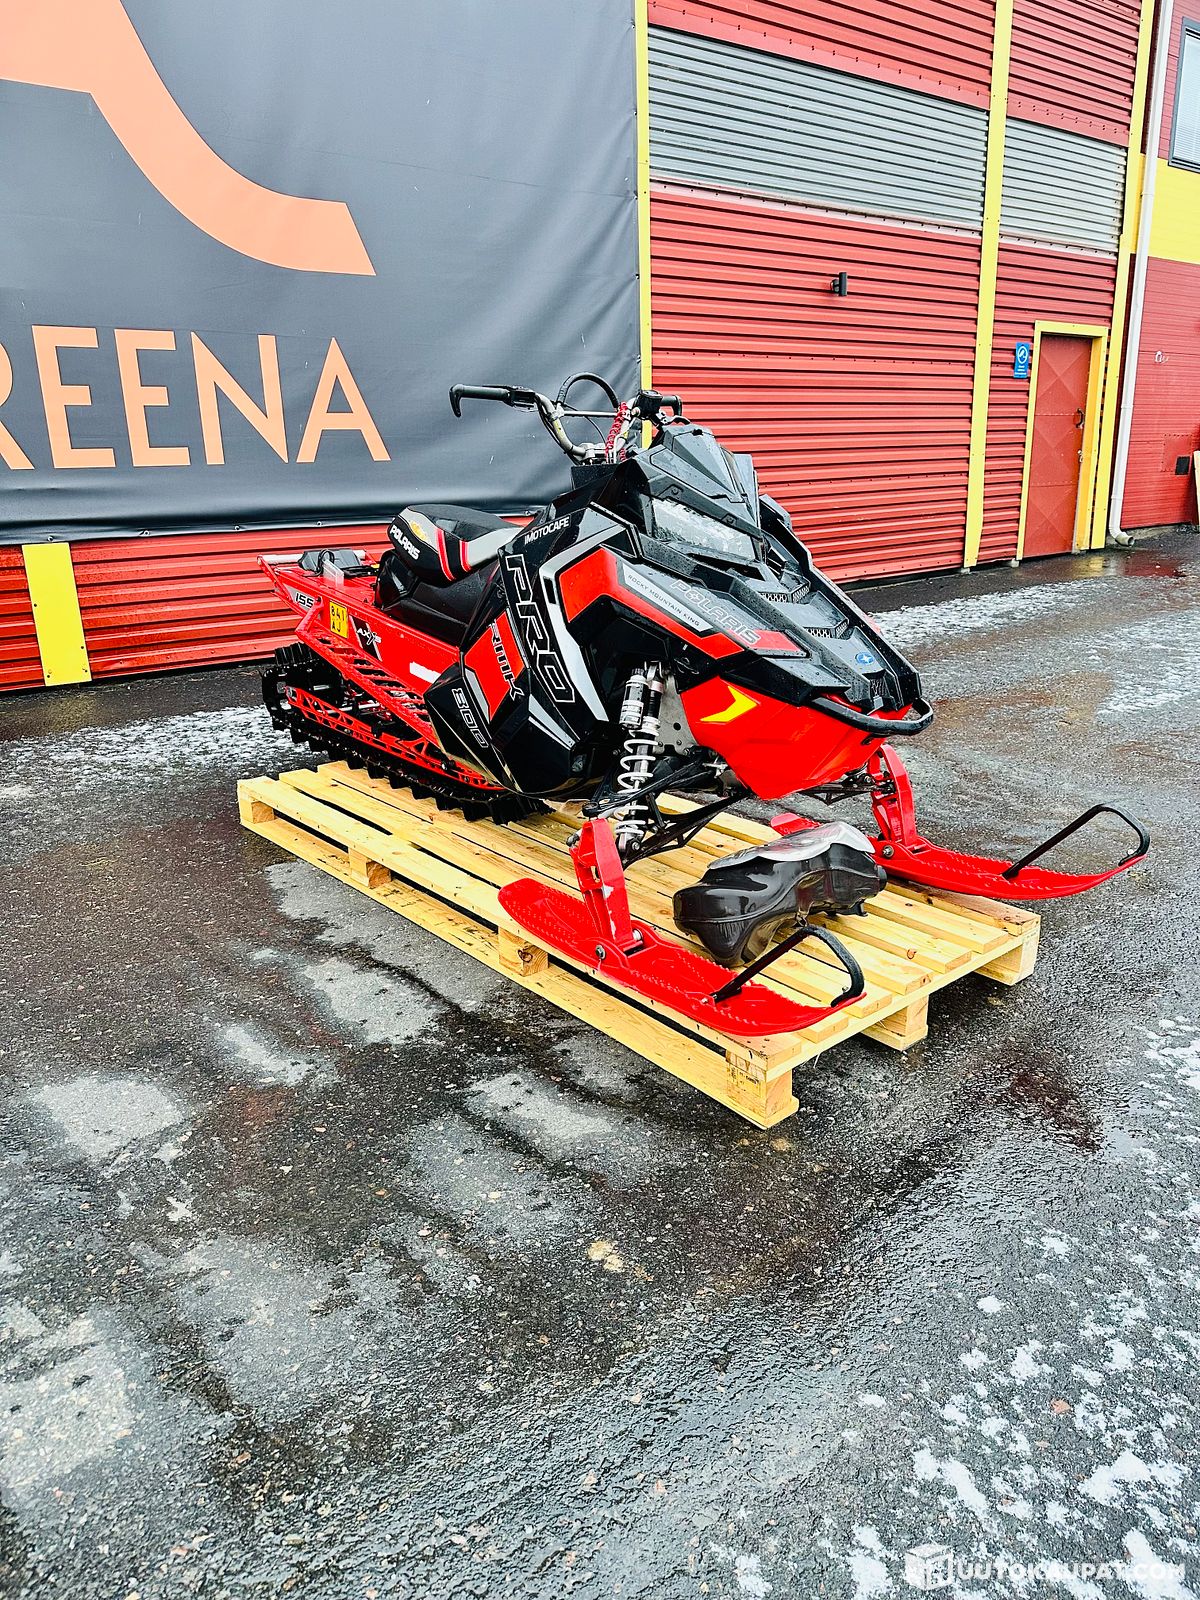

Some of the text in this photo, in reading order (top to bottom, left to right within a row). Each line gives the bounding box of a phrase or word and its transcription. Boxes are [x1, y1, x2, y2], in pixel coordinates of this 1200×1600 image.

[389, 524, 421, 561] POLARIS
[295, 591, 315, 609] 155
[330, 604, 346, 621] 841
[627, 574, 701, 628] ROCKY MOUNTAIN KING
[670, 579, 762, 645] POLARIS
[331, 621, 342, 633] AJ
[505, 554, 576, 703] PRO
[452, 687, 490, 749] 800
